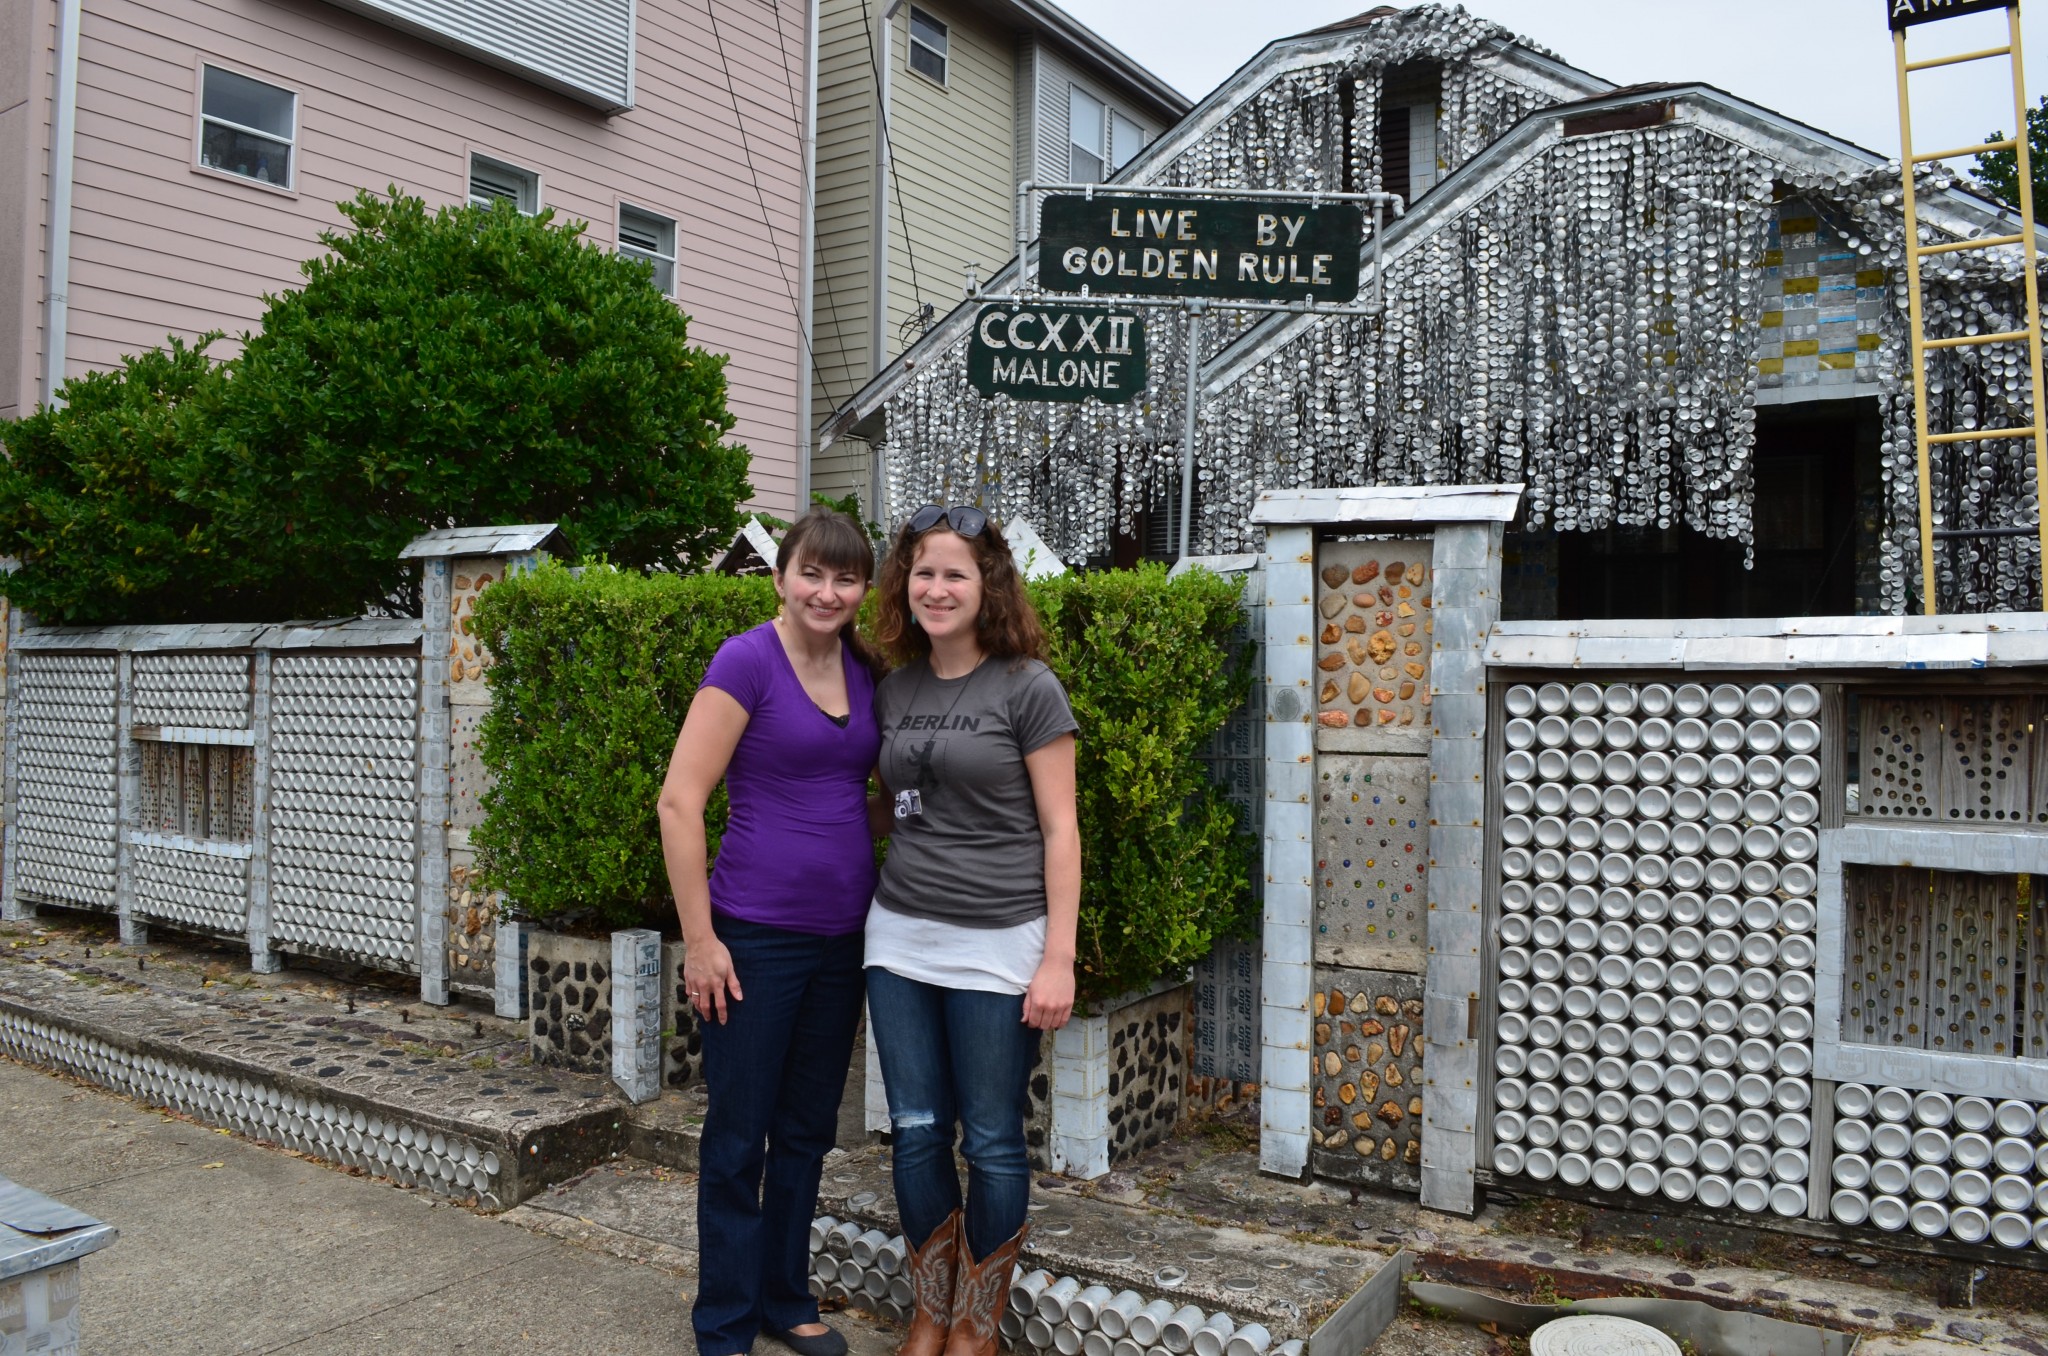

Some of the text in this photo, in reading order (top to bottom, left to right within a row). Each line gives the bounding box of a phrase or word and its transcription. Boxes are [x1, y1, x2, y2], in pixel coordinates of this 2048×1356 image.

[1891, 0, 1980, 18] AM
[1111, 208, 1306, 247] LIVE BY
[1062, 246, 1333, 285] GOLDEN RULE
[979, 311, 1135, 356] CCXXII
[992, 355, 1121, 389] MALONE
[895, 714, 981, 732] BERLIN
